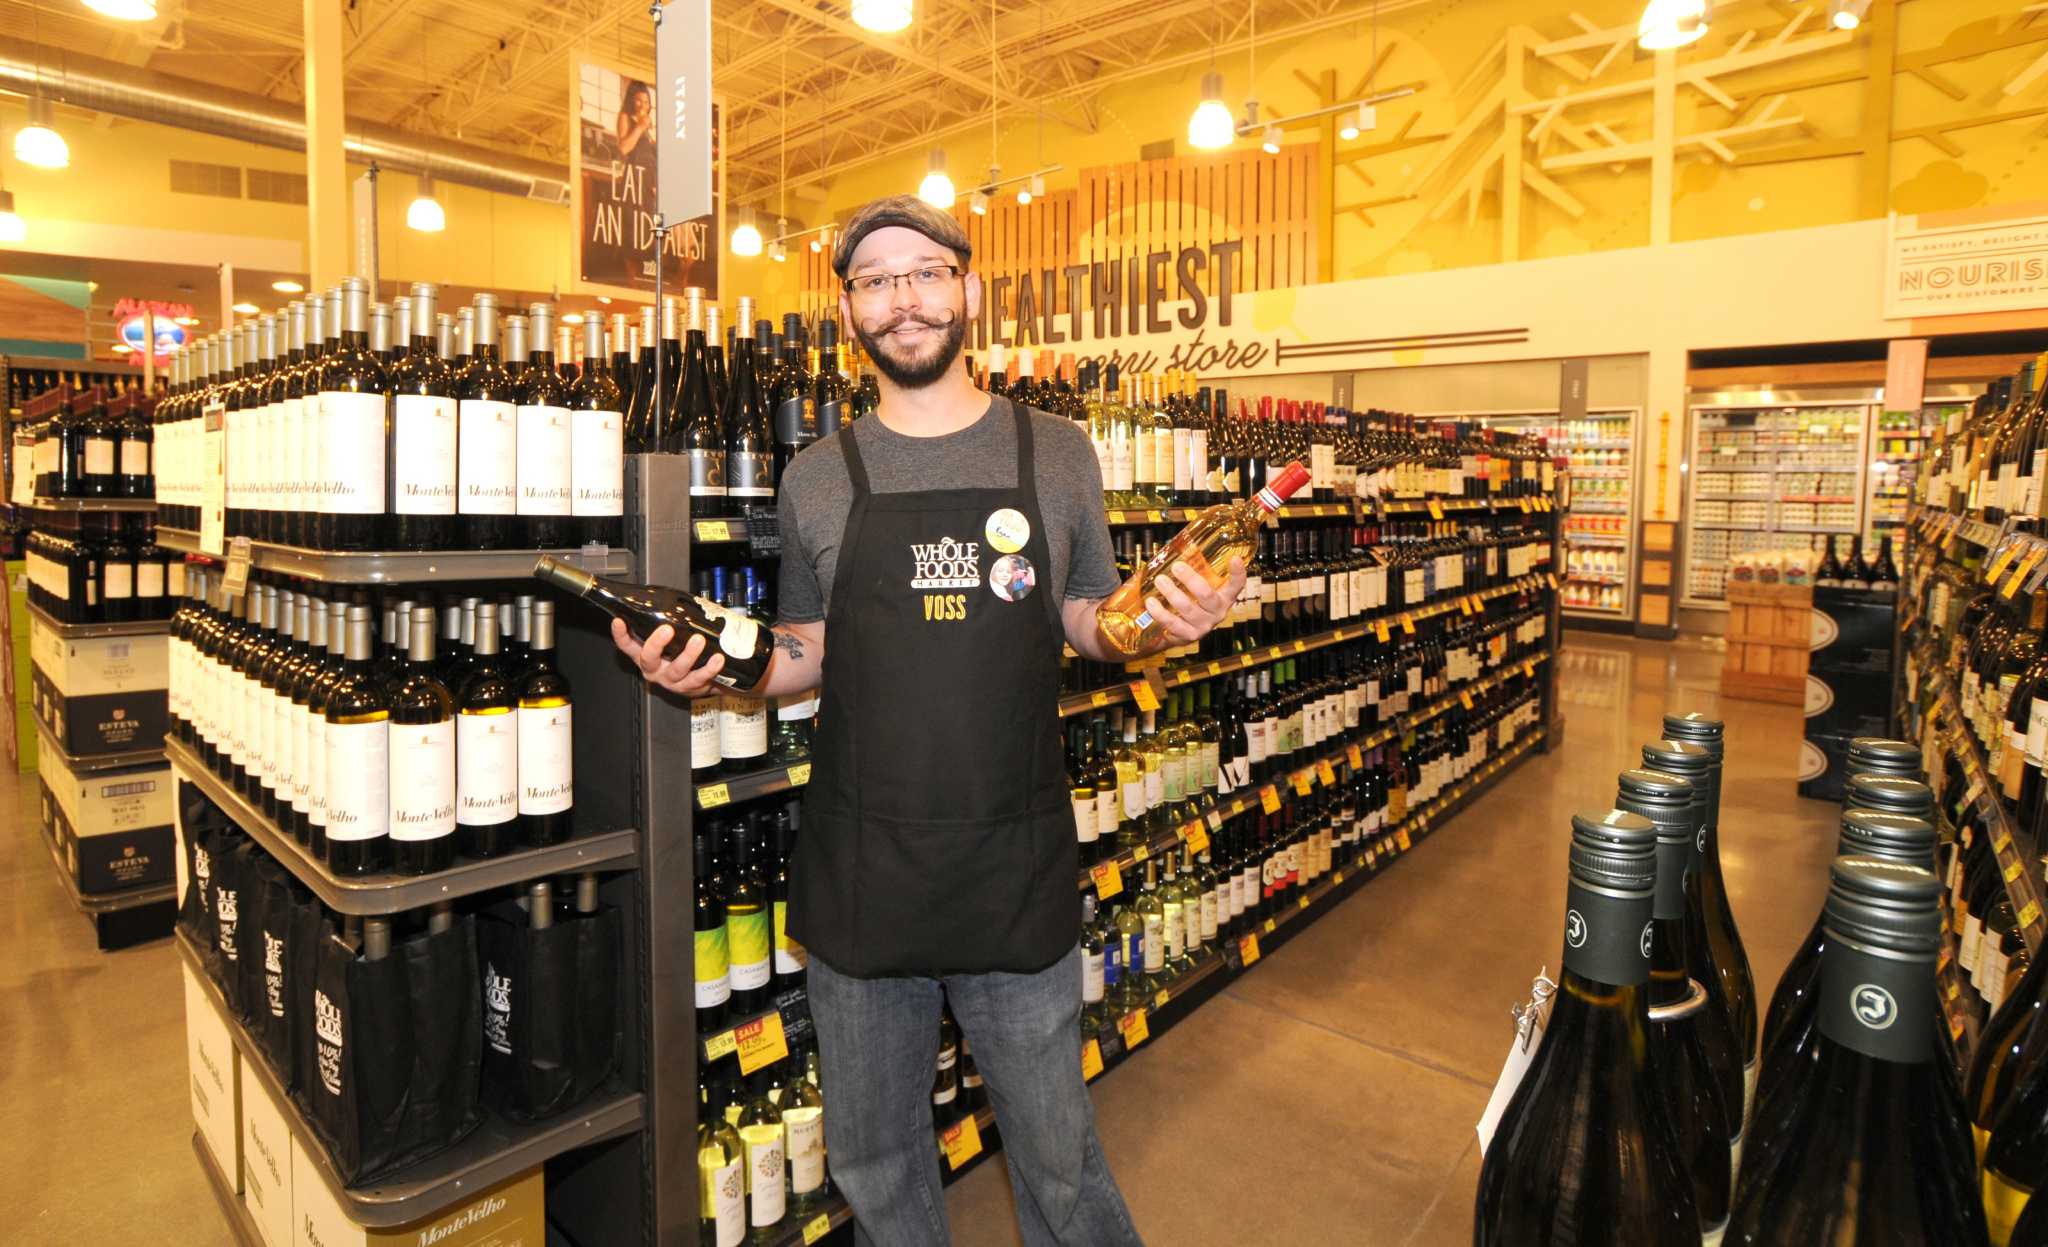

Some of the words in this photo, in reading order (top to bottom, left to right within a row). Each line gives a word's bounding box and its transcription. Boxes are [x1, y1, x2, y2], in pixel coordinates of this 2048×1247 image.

[674, 75, 686, 140] ITALY
[610, 160, 646, 206] EAT
[592, 202, 622, 247] AN
[633, 210, 709, 262] IDALIST
[1899, 258, 2047, 292] NOURIS
[966, 239, 1243, 351] HEALTHIEST
[1957, 286, 2035, 298] CUSTOMERS
[1164, 329, 1269, 375] store
[403, 483, 456, 498] MonteVe
[466, 484, 514, 498] MonteVe
[523, 486, 571, 499] MonteVe
[910, 537, 980, 561] WHOLE
[914, 560, 980, 579] FOODS
[916, 579, 974, 587] MARKET
[923, 593, 967, 621] VOSS
[393, 804, 454, 824] MonteVelh
[737, 1022, 761, 1041] SALE
[416, 1197, 507, 1247] MonteVelho
